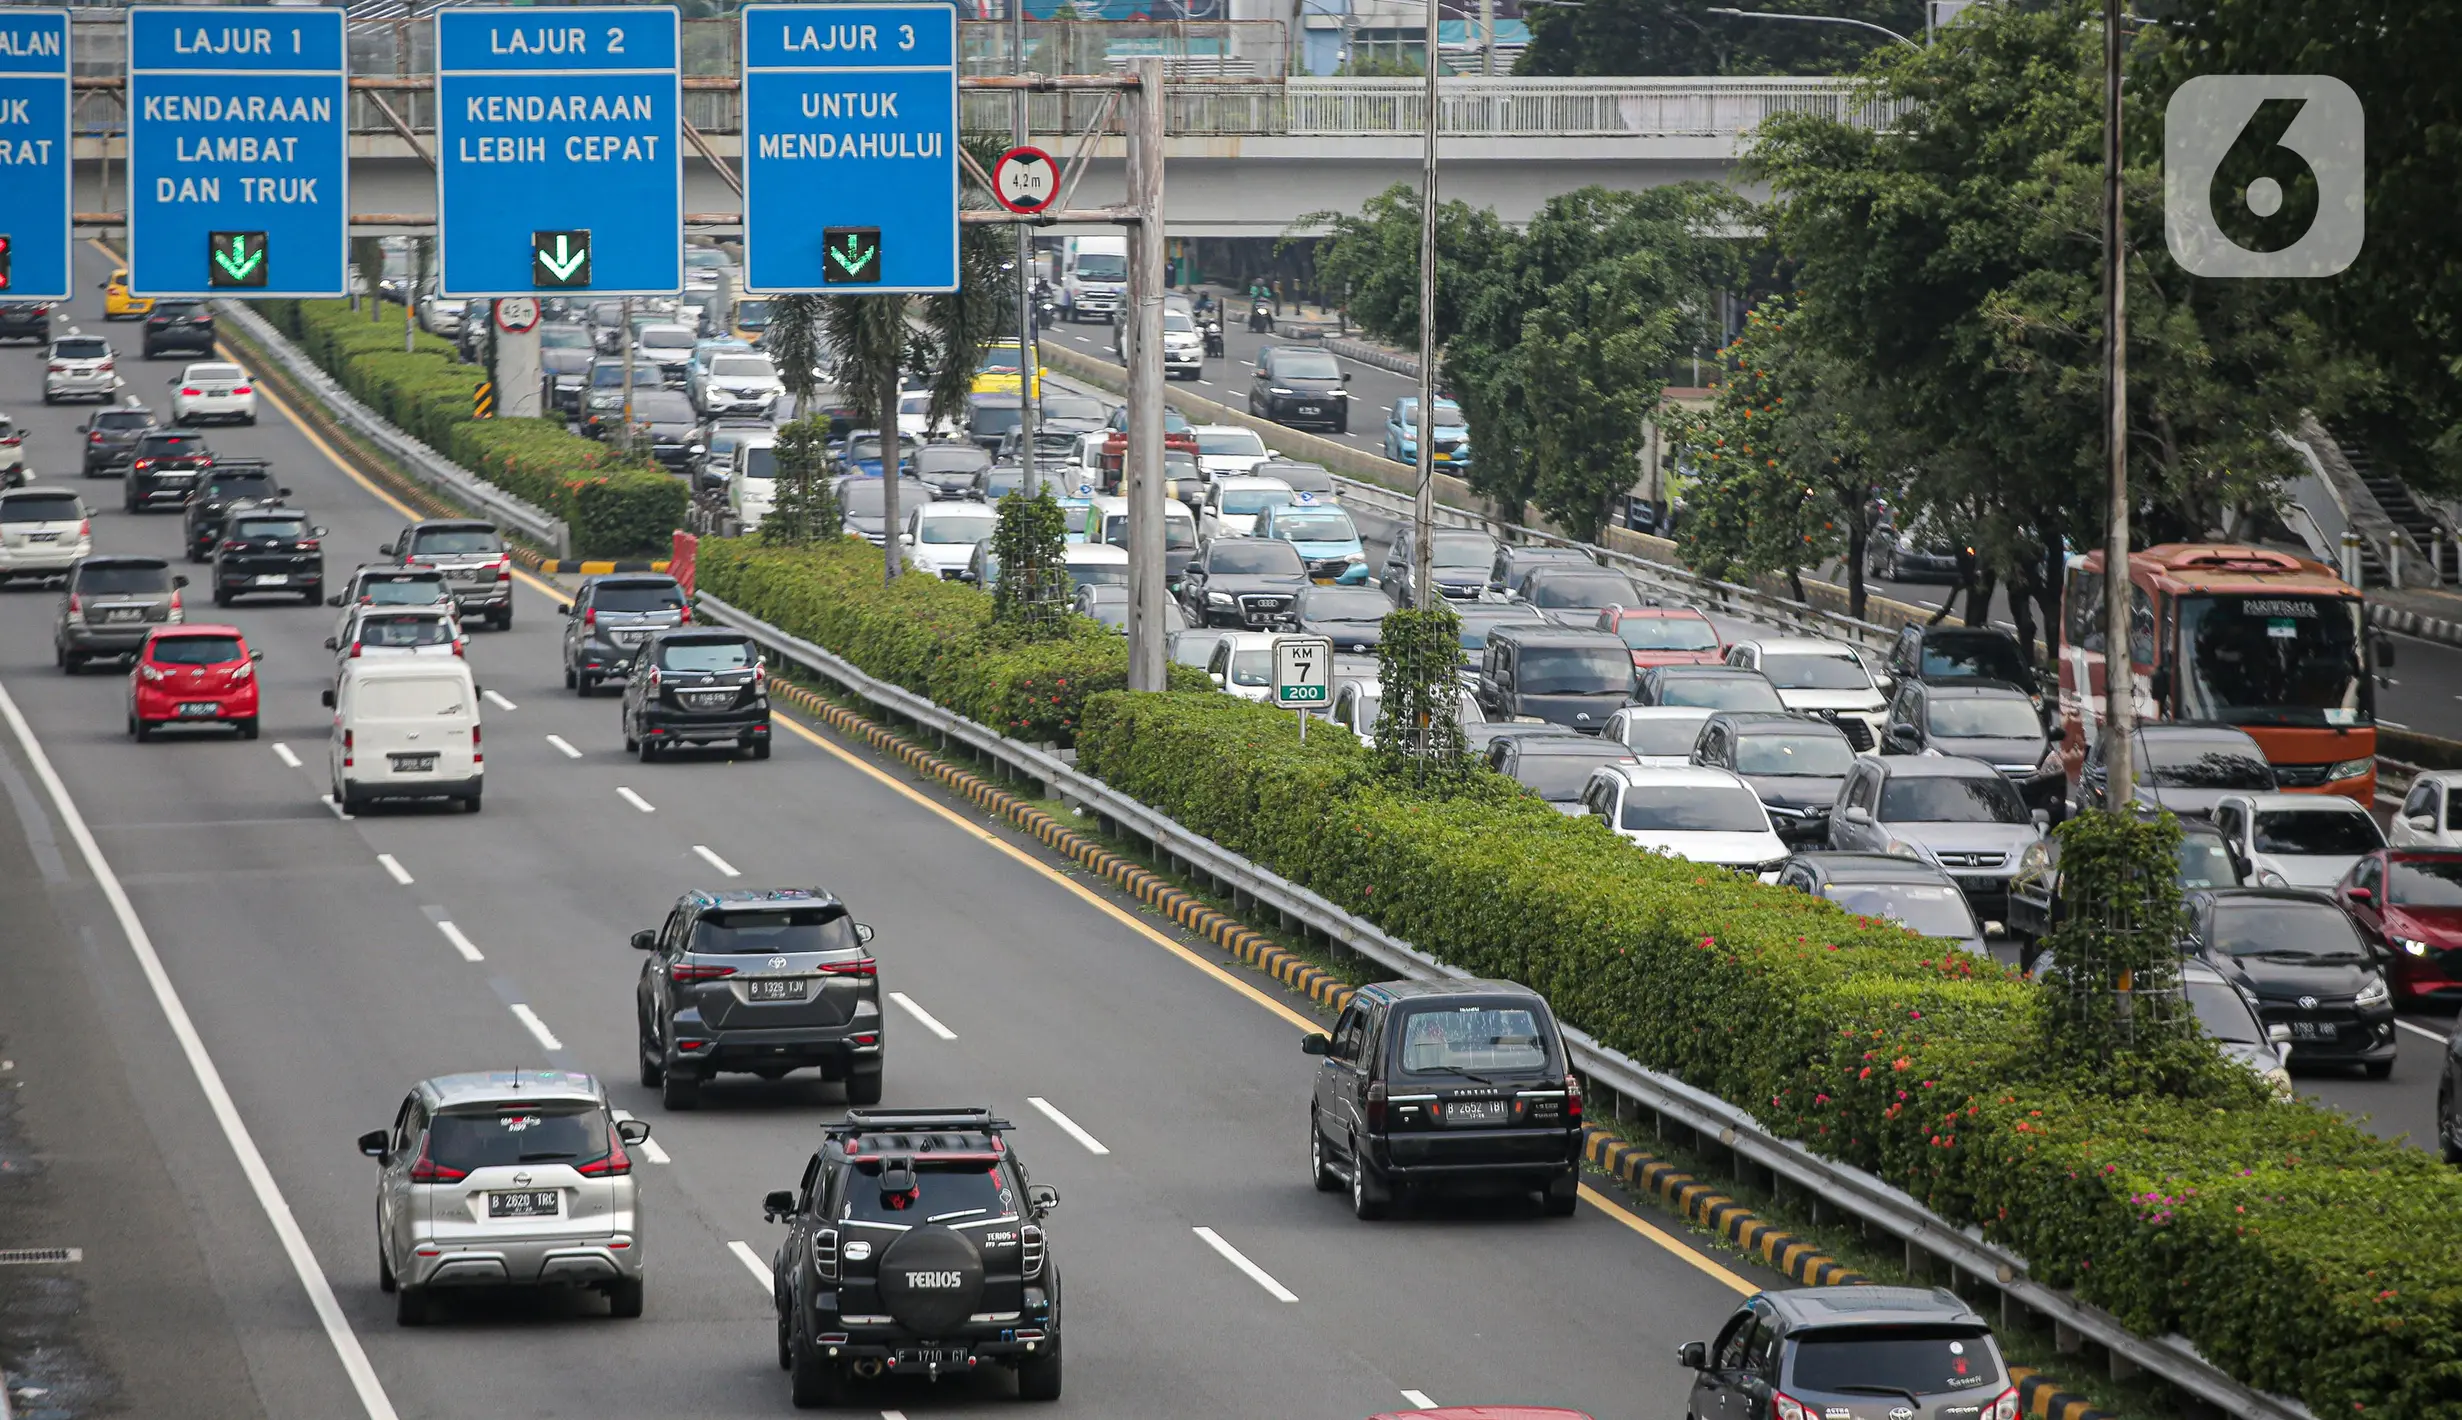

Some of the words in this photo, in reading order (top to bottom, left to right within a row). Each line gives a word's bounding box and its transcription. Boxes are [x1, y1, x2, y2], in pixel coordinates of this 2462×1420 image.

[175, 28, 271, 54] LAJUR
[292, 29, 301, 54] 1
[491, 28, 586, 54] LAJUR
[607, 28, 625, 53] 2
[783, 25, 877, 51] LAJUR
[898, 24, 915, 50] 3
[144, 96, 331, 122] KENDARAAN
[467, 96, 652, 122] KENDARAAN
[802, 92, 898, 118] UNTUK
[176, 137, 299, 162] LAMBAT
[460, 137, 545, 162] LEBIH
[565, 136, 659, 162] CEPAT
[759, 133, 942, 159] MENDAHULUI
[157, 178, 220, 203] DAN
[240, 178, 318, 203] TRUK
[1012, 173, 1029, 189] 4,2
[1031, 176, 1041, 188] m
[2243, 600, 2318, 618] PARIWISATA
[1292, 648, 1312, 659] KM
[1294, 662, 1311, 683] 7
[1289, 687, 1318, 699] 200
[751, 982, 758, 993] B
[1453, 1088, 1499, 1096] PANTHER
[1447, 1103, 1454, 1115] B
[1459, 1101, 1482, 1114] 2652
[492, 1196, 500, 1208] B
[535, 1192, 555, 1207] TRC
[987, 1231, 1012, 1241] TERIOS
[905, 1271, 961, 1288] TERIOS
[918, 1349, 942, 1362] 1710
[952, 1349, 965, 1362] GT
